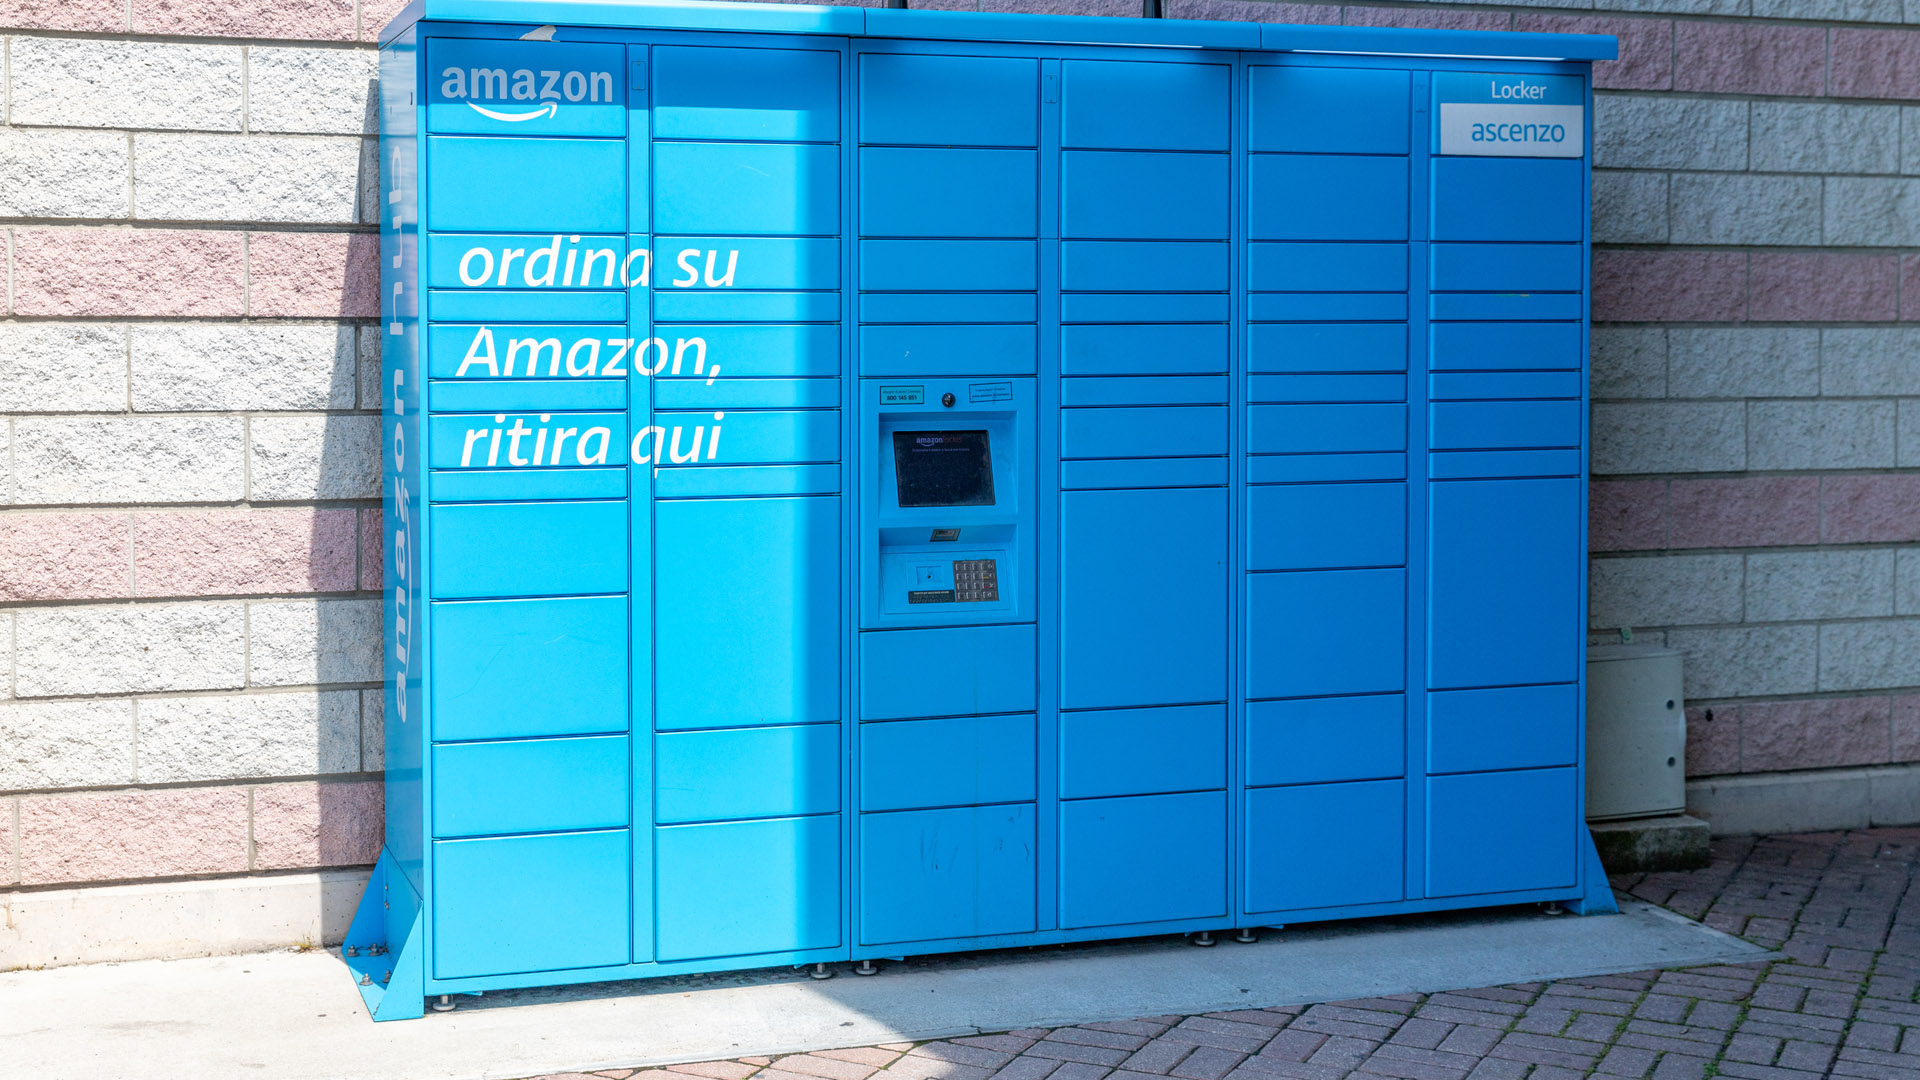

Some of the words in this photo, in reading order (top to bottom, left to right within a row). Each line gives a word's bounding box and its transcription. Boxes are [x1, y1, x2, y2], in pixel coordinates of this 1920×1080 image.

[441, 66, 613, 103] amazon
[1491, 80, 1547, 99] Locker
[1471, 122, 1565, 143] ascenzo
[388, 145, 404, 334] hub
[458, 234, 653, 288] ordina
[672, 248, 739, 288] su
[455, 325, 721, 386] Amazon,
[460, 412, 611, 467] ritira
[630, 411, 725, 479] qui
[393, 369, 407, 724] amazon
